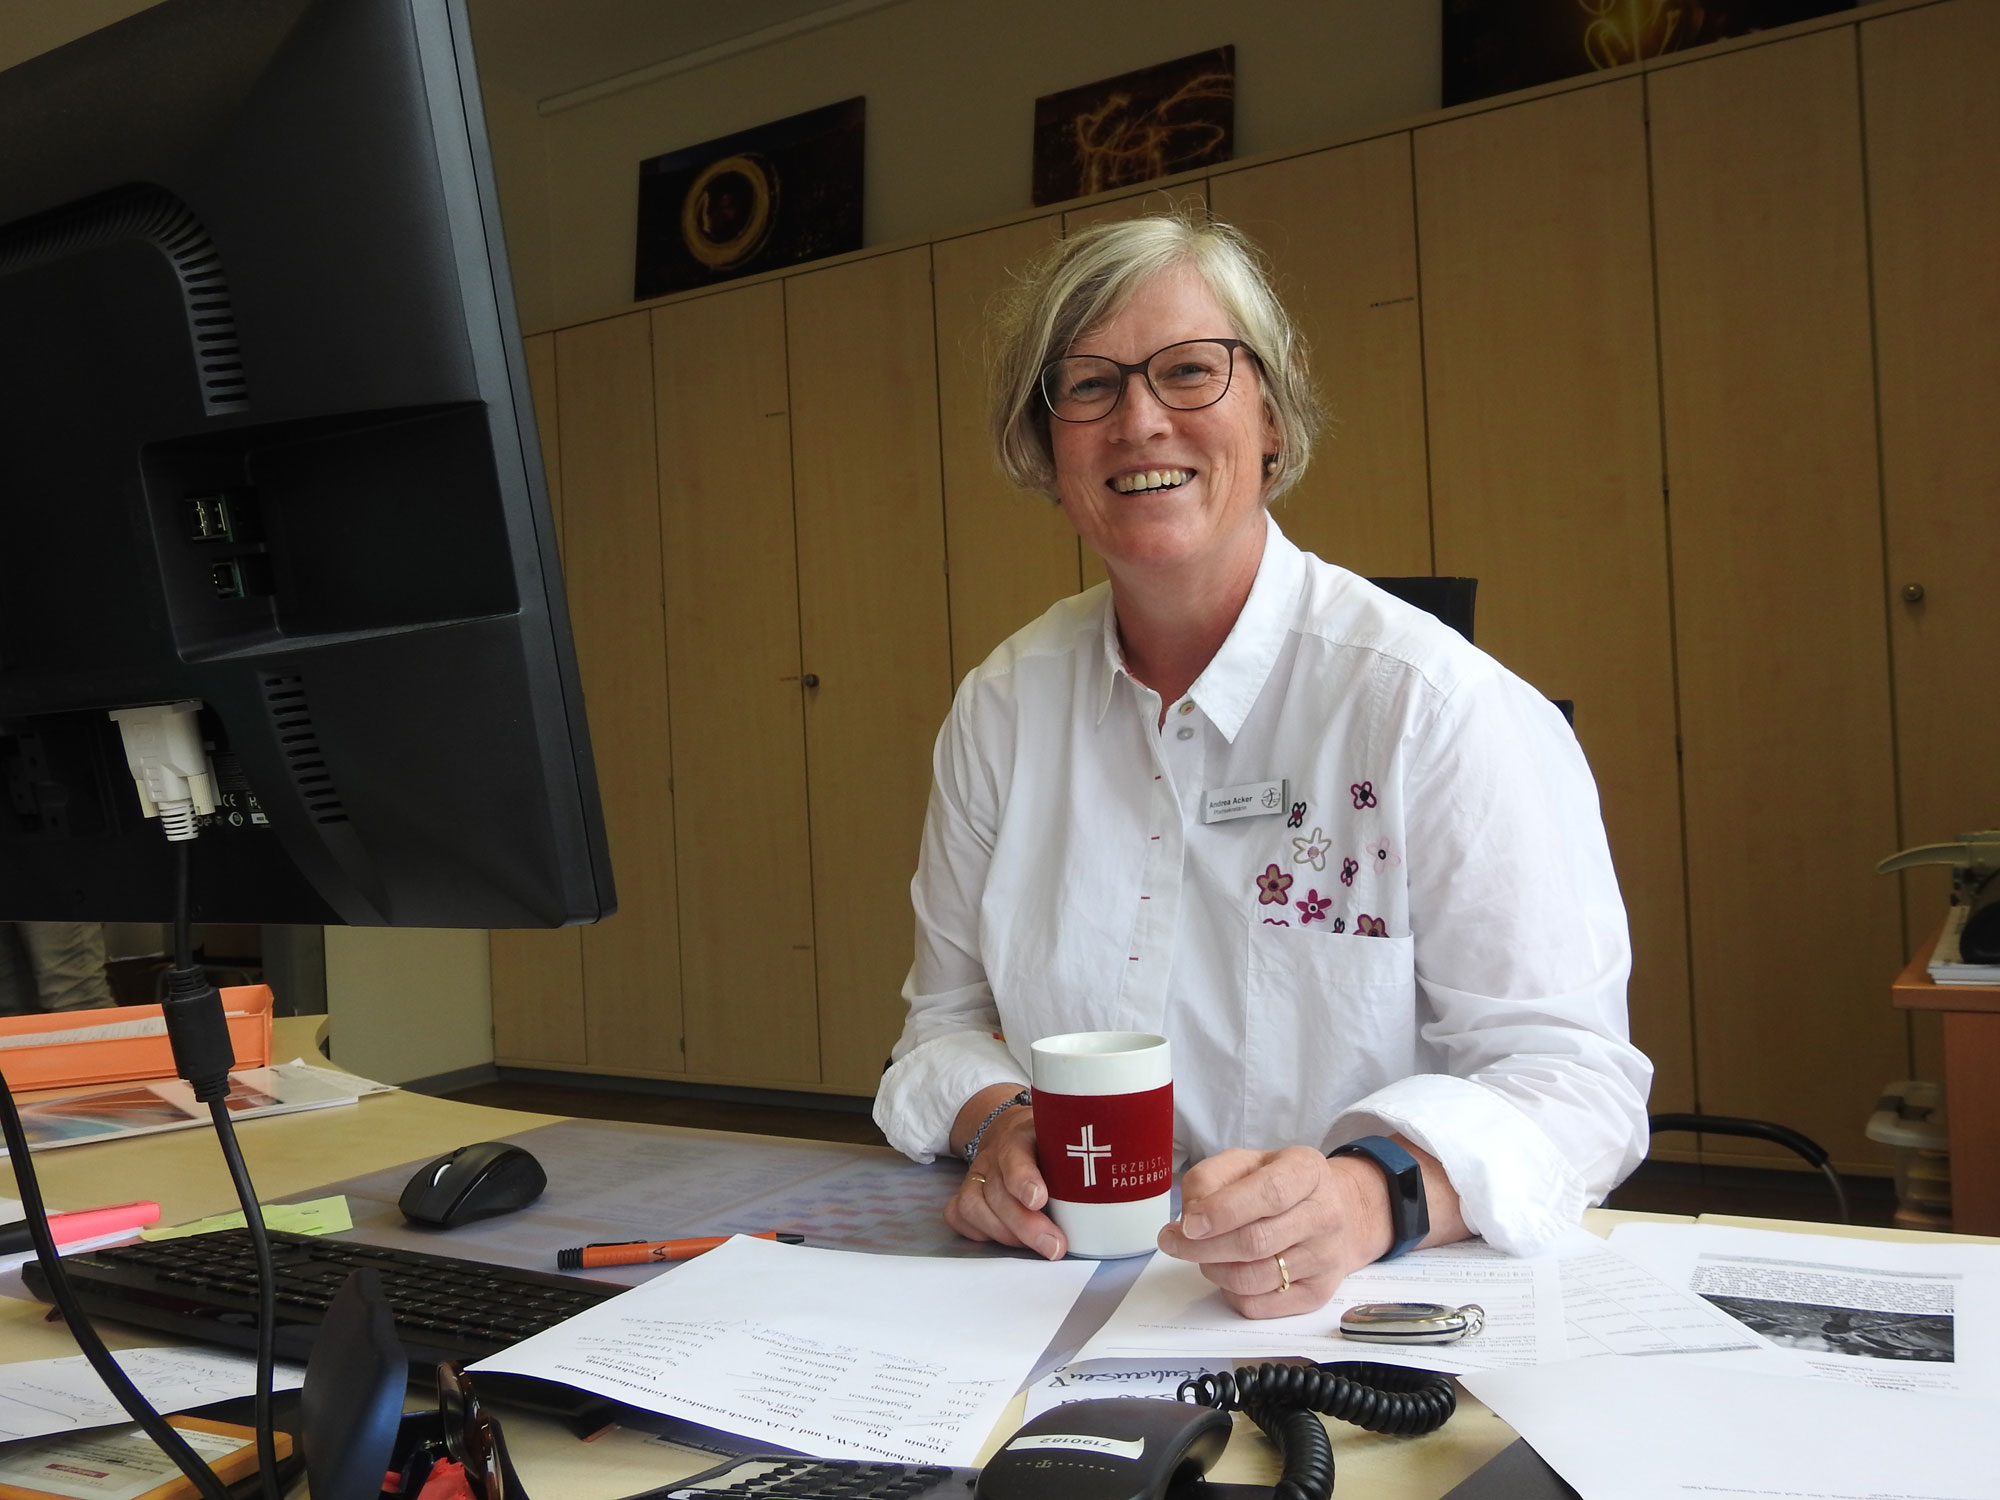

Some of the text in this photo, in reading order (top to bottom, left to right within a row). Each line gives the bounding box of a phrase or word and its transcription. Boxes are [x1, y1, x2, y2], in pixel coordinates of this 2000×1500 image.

[1209, 796, 1253, 809] Andrea Acker
[1111, 1156, 1166, 1175] ERZBIST
[1112, 1167, 1170, 1188] PADERBO
[805, 1360, 848, 1373] Manfred
[554, 1365, 667, 1398] Gottesdienstordnung
[814, 1374, 838, 1382] Karl
[875, 1373, 930, 1388] Finnentrop
[804, 1384, 827, 1392] Otto
[871, 1385, 921, 1399] Ostentrop
[670, 1396, 727, 1414] geänderte
[739, 1394, 773, 1406] Meyer
[792, 1394, 816, 1403] Karl
[585, 1359, 947, 1455] Termin Ort Name Verschiebung
[729, 1412, 763, 1424] durch
[798, 1428, 822, 1437] und
[1039, 1438, 1111, 1449] 7190182
[863, 1446, 936, 1465] erschobene
